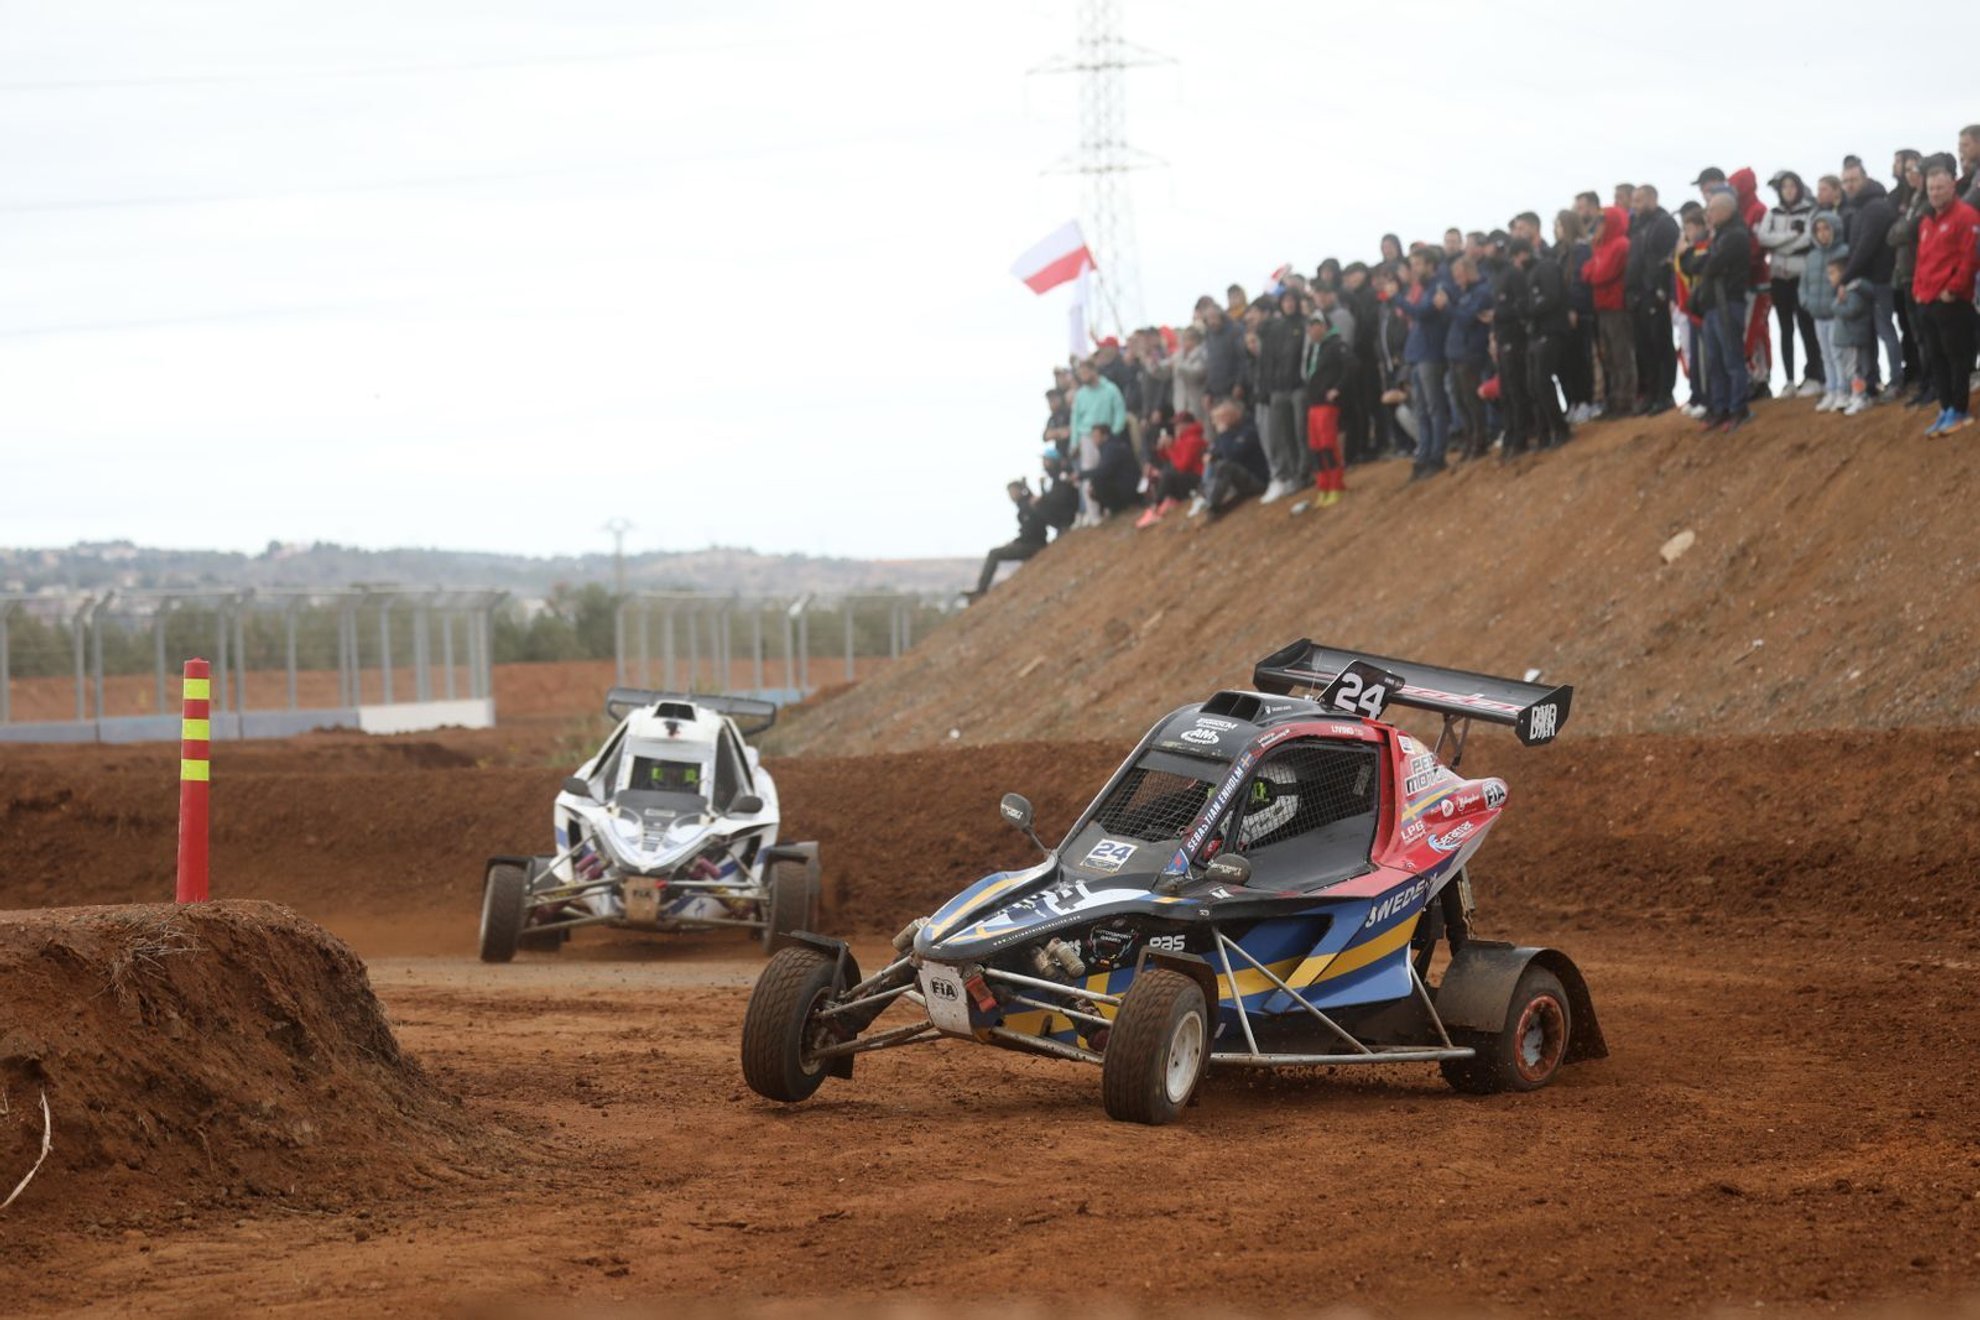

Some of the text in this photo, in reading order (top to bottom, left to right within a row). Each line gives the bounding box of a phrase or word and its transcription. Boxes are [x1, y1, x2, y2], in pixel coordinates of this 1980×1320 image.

[1334, 672, 1386, 720] 24
[1187, 765, 1245, 853] SEBASTIAN ENHOLM
[1091, 842, 1133, 862] 24
